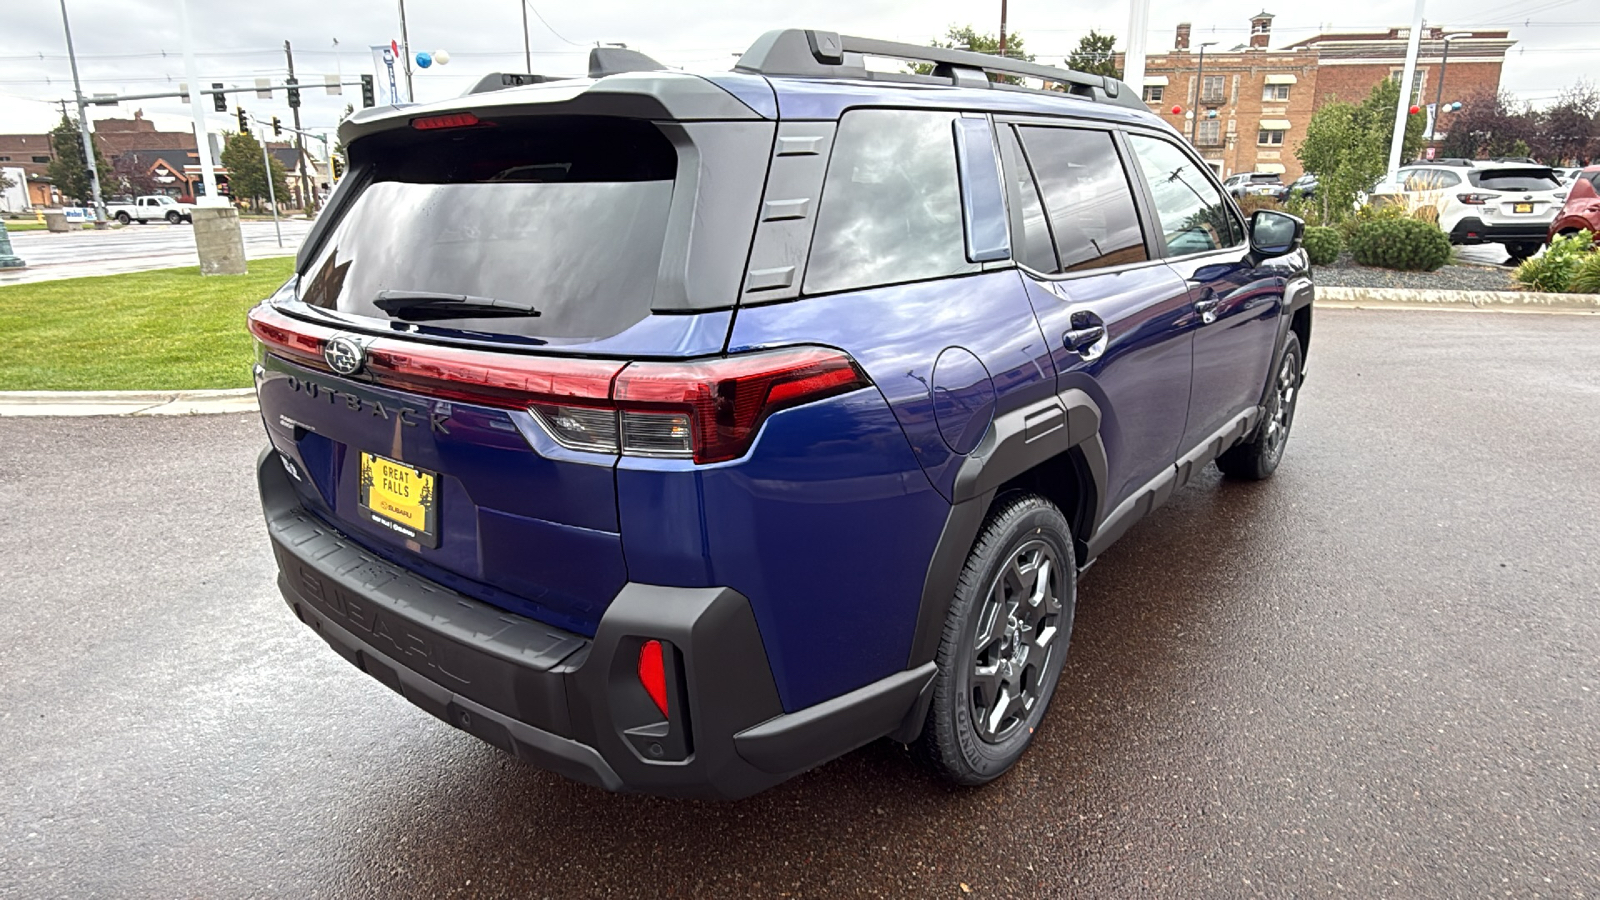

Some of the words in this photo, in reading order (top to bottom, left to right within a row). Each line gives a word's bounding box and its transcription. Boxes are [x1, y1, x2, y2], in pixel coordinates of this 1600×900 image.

[288, 375, 450, 435] OUTBACK
[382, 465, 409, 484] GREAT
[382, 477, 410, 498] FALLS
[387, 504, 413, 519] SUBARU
